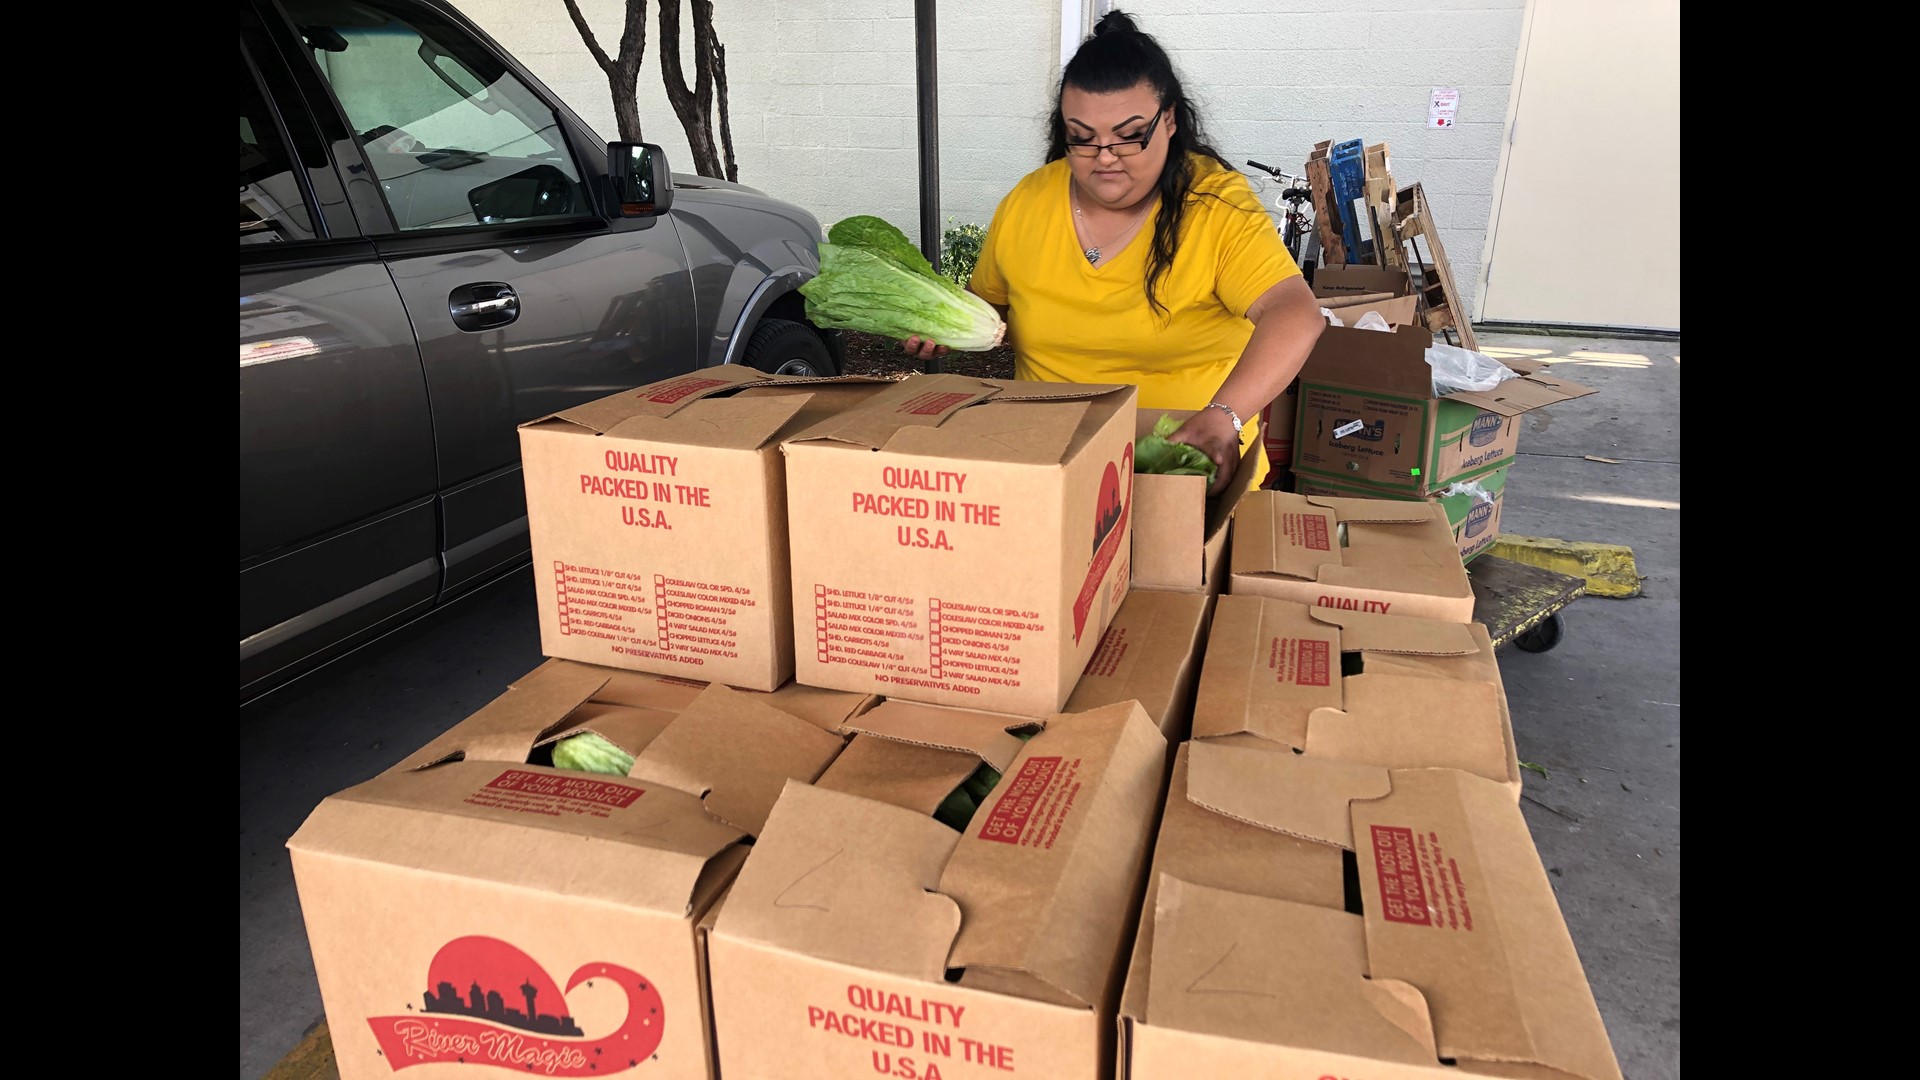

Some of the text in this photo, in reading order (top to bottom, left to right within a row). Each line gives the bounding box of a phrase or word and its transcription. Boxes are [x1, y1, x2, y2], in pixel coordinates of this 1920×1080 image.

[1329, 440, 1356, 452] Iceberg
[1357, 446, 1384, 456] Lettuce
[1484, 448, 1504, 461] Lettuce
[605, 450, 678, 476] QUALITY
[581, 475, 711, 507] PACKED IN THE
[883, 467, 967, 494] QUALITY
[622, 506, 672, 530] U.S.A.
[853, 493, 1000, 526] PACKED IN THE
[898, 526, 954, 551] U.S.A.
[1317, 596, 1392, 614] QUALITY
[612, 646, 704, 666] NO PRESERVATIVES ADDED
[875, 674, 980, 695] NO PRESERVATIVES ADDED
[497, 780, 627, 805] OF YOUR PRODUCT
[507, 772, 637, 798] GET THE MOST OUT
[987, 760, 1042, 836] GET THE MOST OUT
[1003, 760, 1056, 838] OF YOUR PRODUCT
[1376, 830, 1406, 919] GET THE MOST OUT
[1393, 831, 1425, 920] OF YOUR PRODUCT
[847, 984, 965, 1029] QUALITY
[394, 1019, 587, 1074] River Magic
[808, 1006, 1015, 1072] PACKED IN THE
